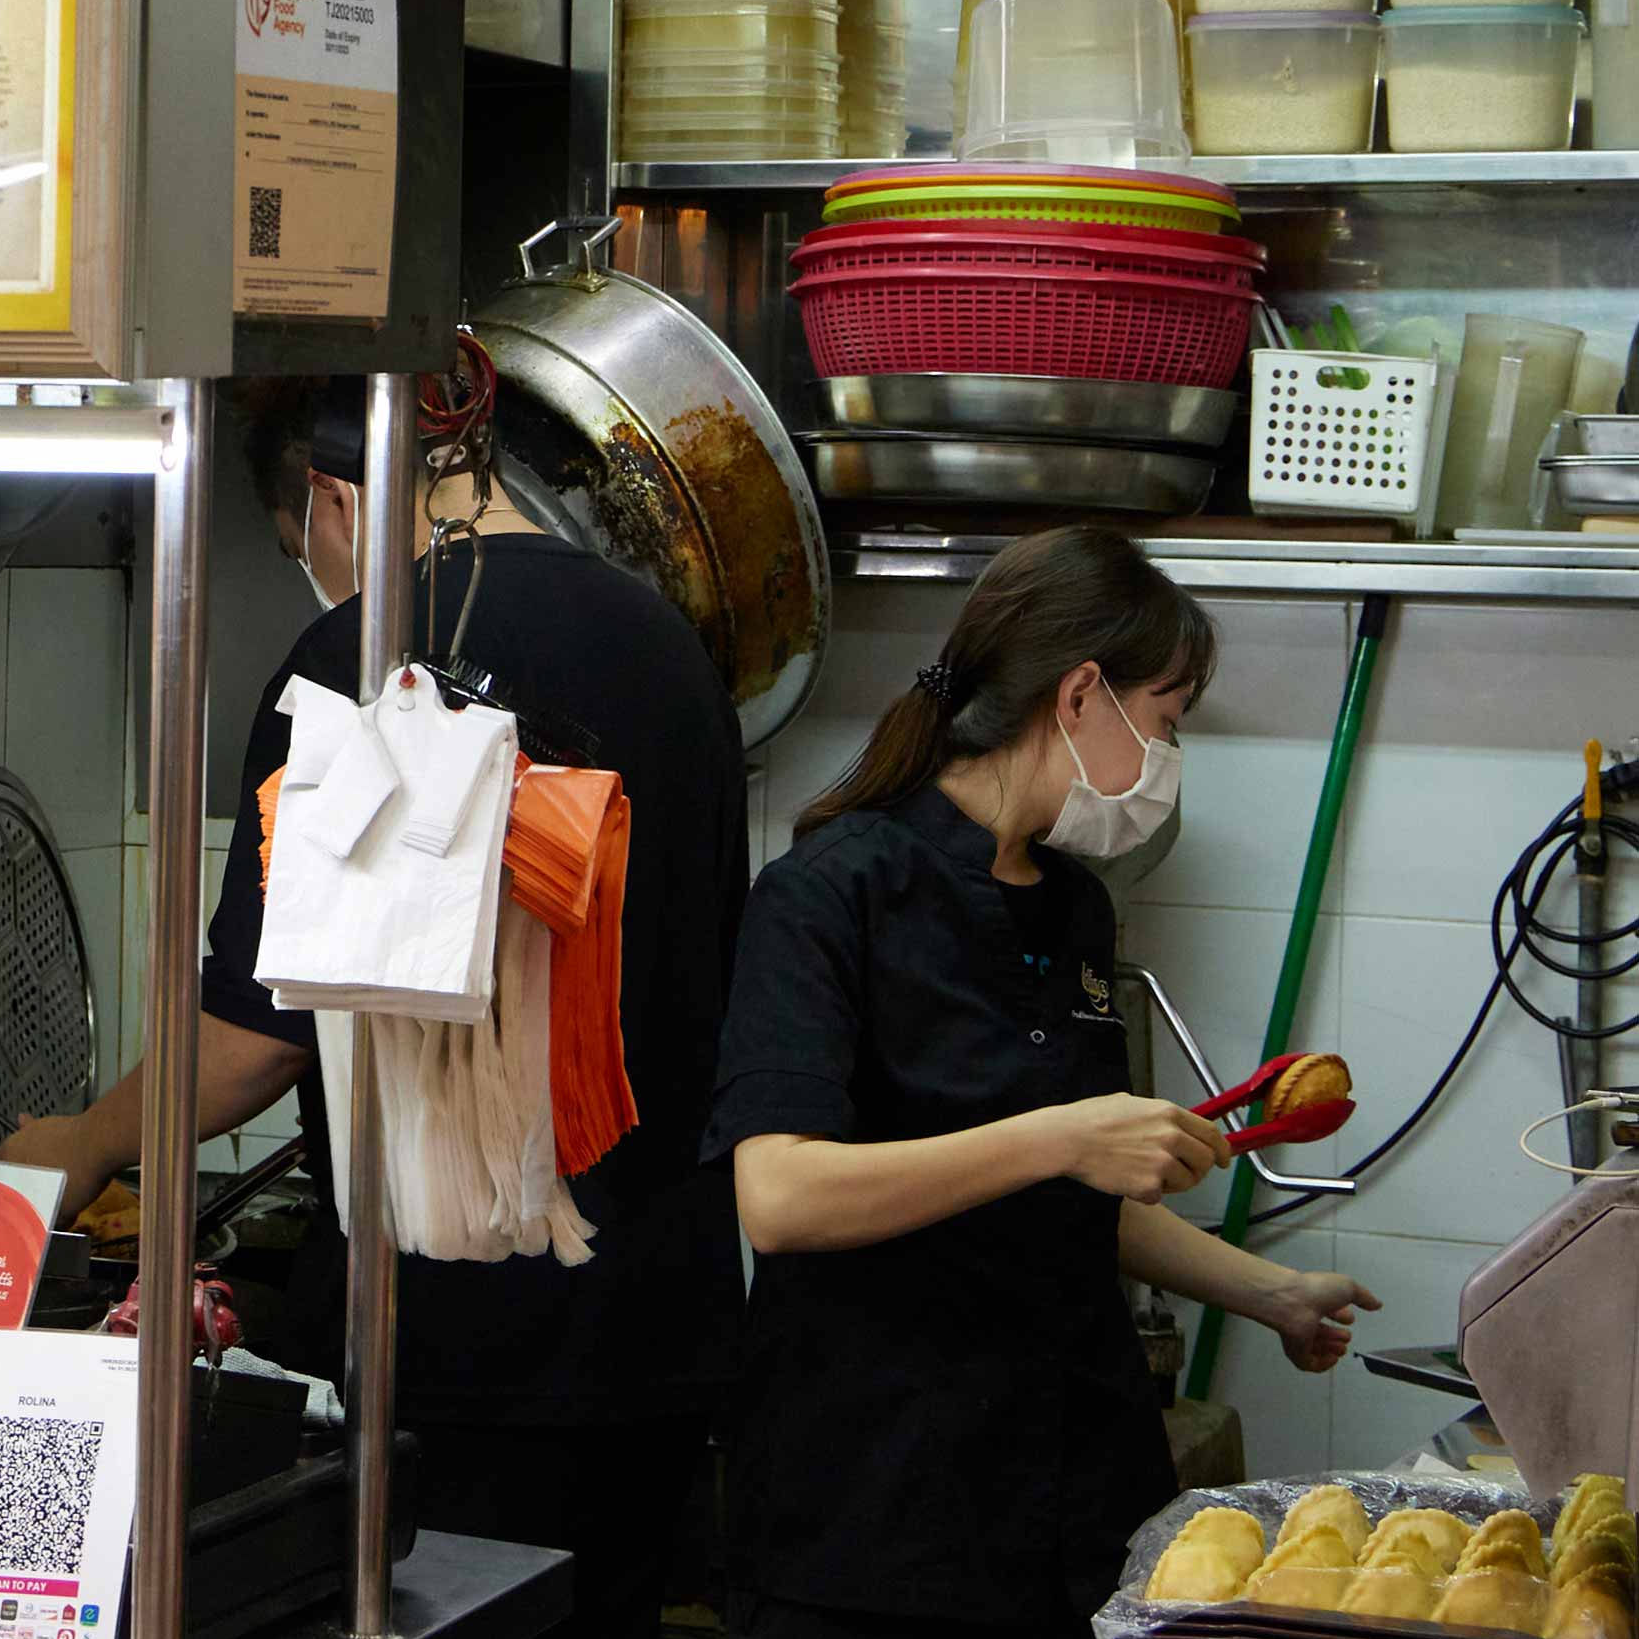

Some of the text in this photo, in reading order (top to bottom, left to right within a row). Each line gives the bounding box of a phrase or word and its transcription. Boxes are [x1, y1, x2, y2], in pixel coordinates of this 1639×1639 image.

[273, 16, 306, 38] Agency
[18, 1396, 56, 1407] ROLINA
[12, 1580, 24, 1590] TO
[27, 1581, 47, 1592] PAY
